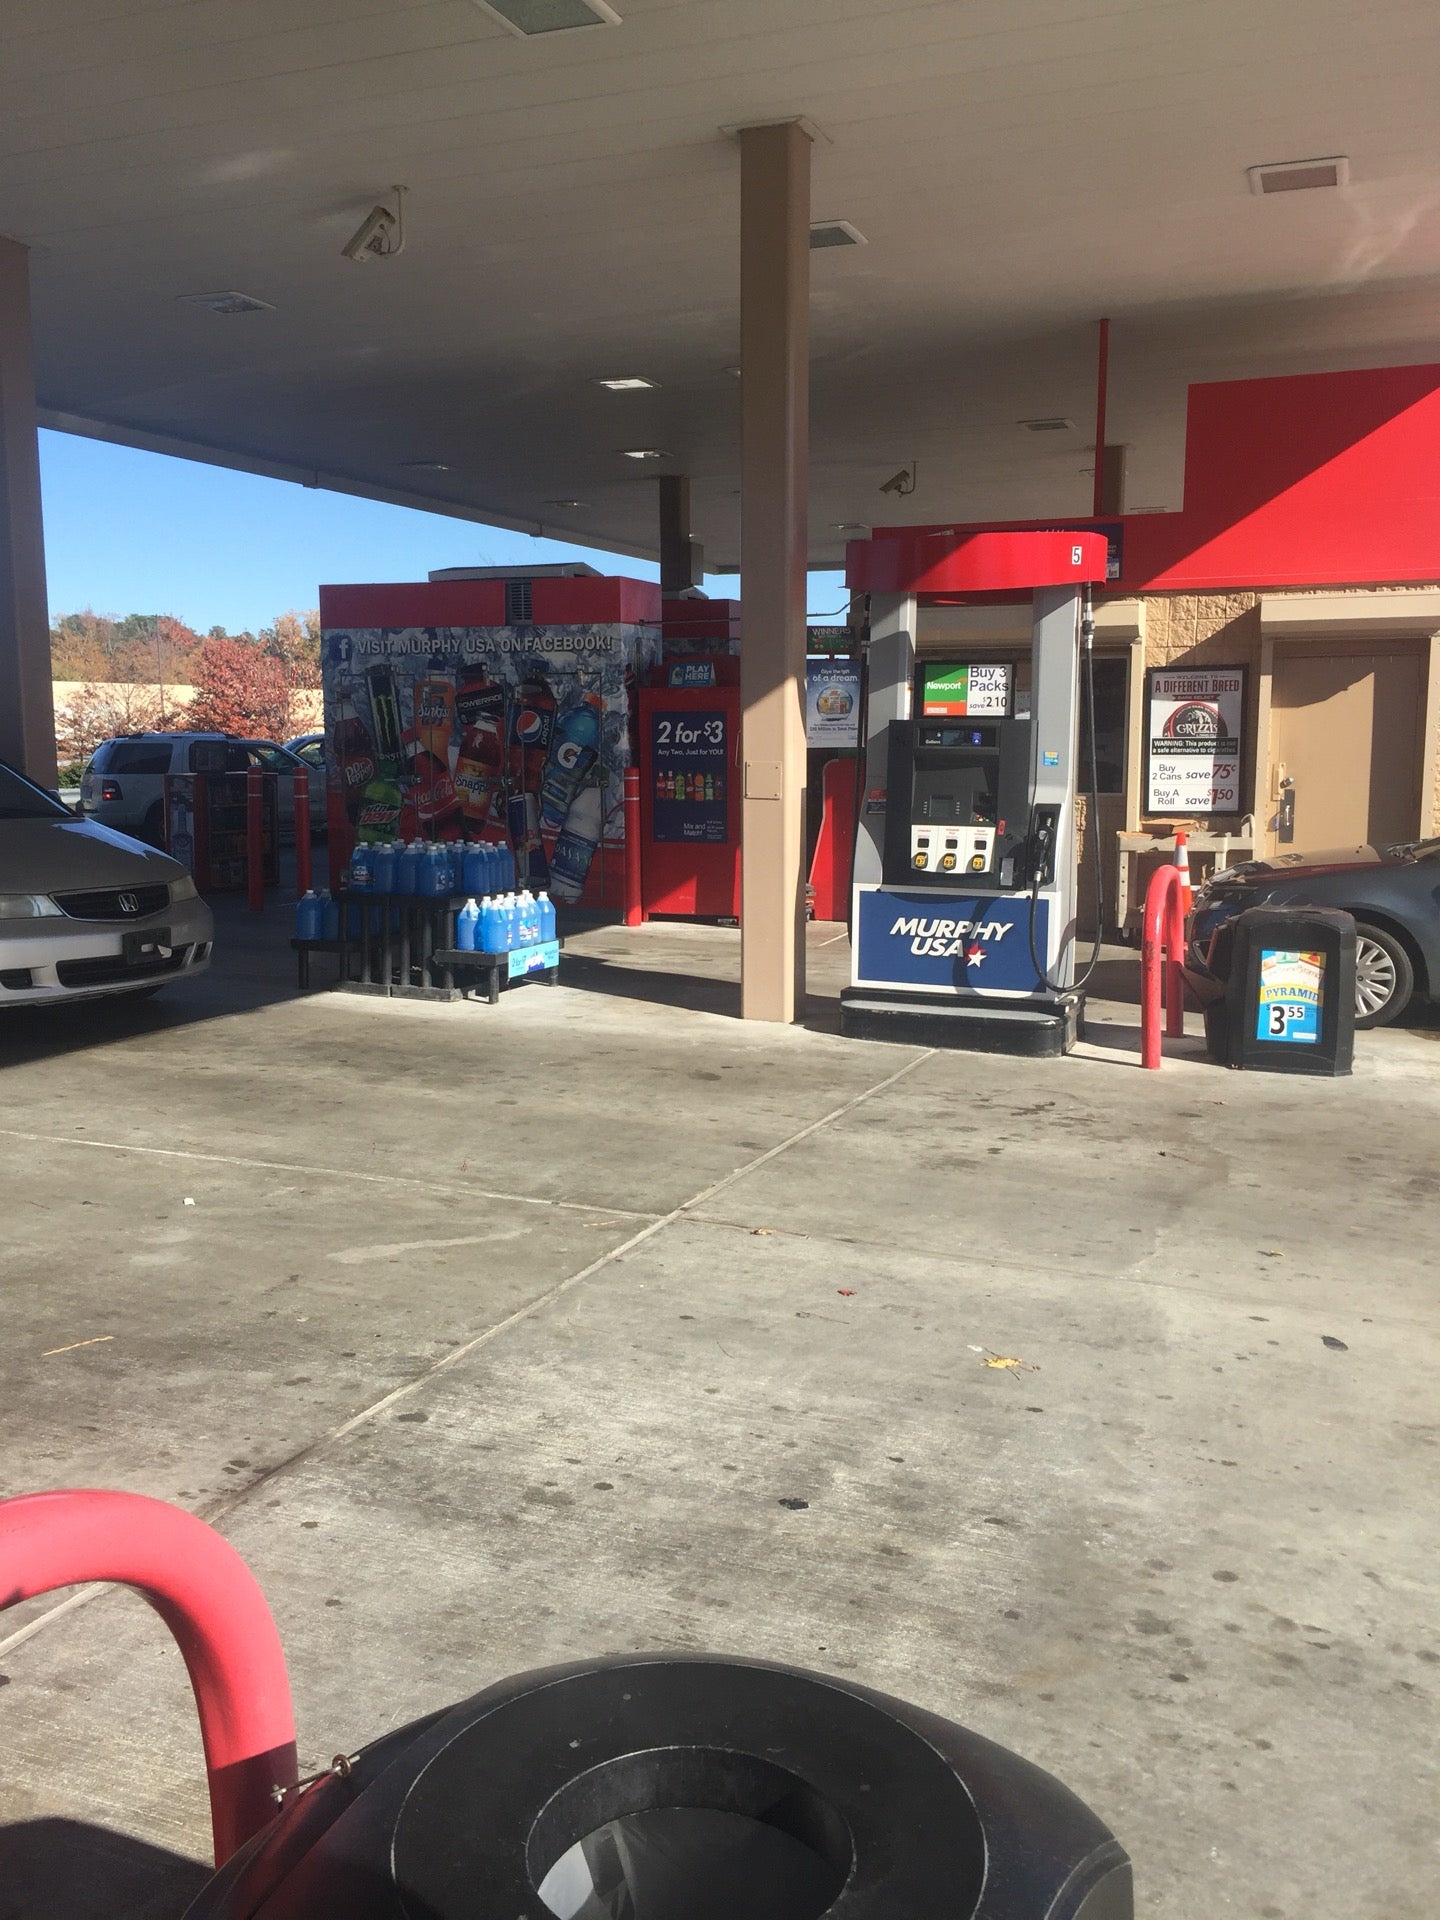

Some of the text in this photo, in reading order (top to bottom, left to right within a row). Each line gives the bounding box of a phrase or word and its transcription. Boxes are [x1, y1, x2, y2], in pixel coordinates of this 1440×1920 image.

[1073, 547, 1081, 564] 5
[358, 638, 395, 655] VISIT
[398, 639, 461, 654] MURPHY
[465, 638, 496, 653] USA
[500, 638, 521, 653] ON
[524, 636, 613, 652] FACEBOOK!
[686, 664, 710, 673] PLAY
[970, 665, 1007, 680] Buy 3
[684, 672, 709, 680] HERE
[812, 674, 822, 682] of
[830, 674, 858, 682] dream
[926, 681, 961, 691] Newport
[969, 680, 1009, 692] Packs
[1155, 679, 1240, 693] A DIFFERENT BREED
[656, 720, 724, 744] 2 for $3
[1198, 740, 1218, 749] product
[657, 749, 670, 758] Any
[671, 749, 685, 757] Two,
[685, 748, 698, 757] Just
[699, 748, 708, 756] for
[1159, 764, 1176, 773] Buy
[345, 763, 374, 786] Pepper
[1185, 771, 1211, 779] save
[1153, 789, 1180, 798] Buy A
[1157, 797, 1175, 805] Roll
[1185, 797, 1210, 805] save
[889, 917, 1014, 942] MURPHY
[910, 937, 964, 957] USA
[1265, 987, 1320, 1002] PYRAMID
